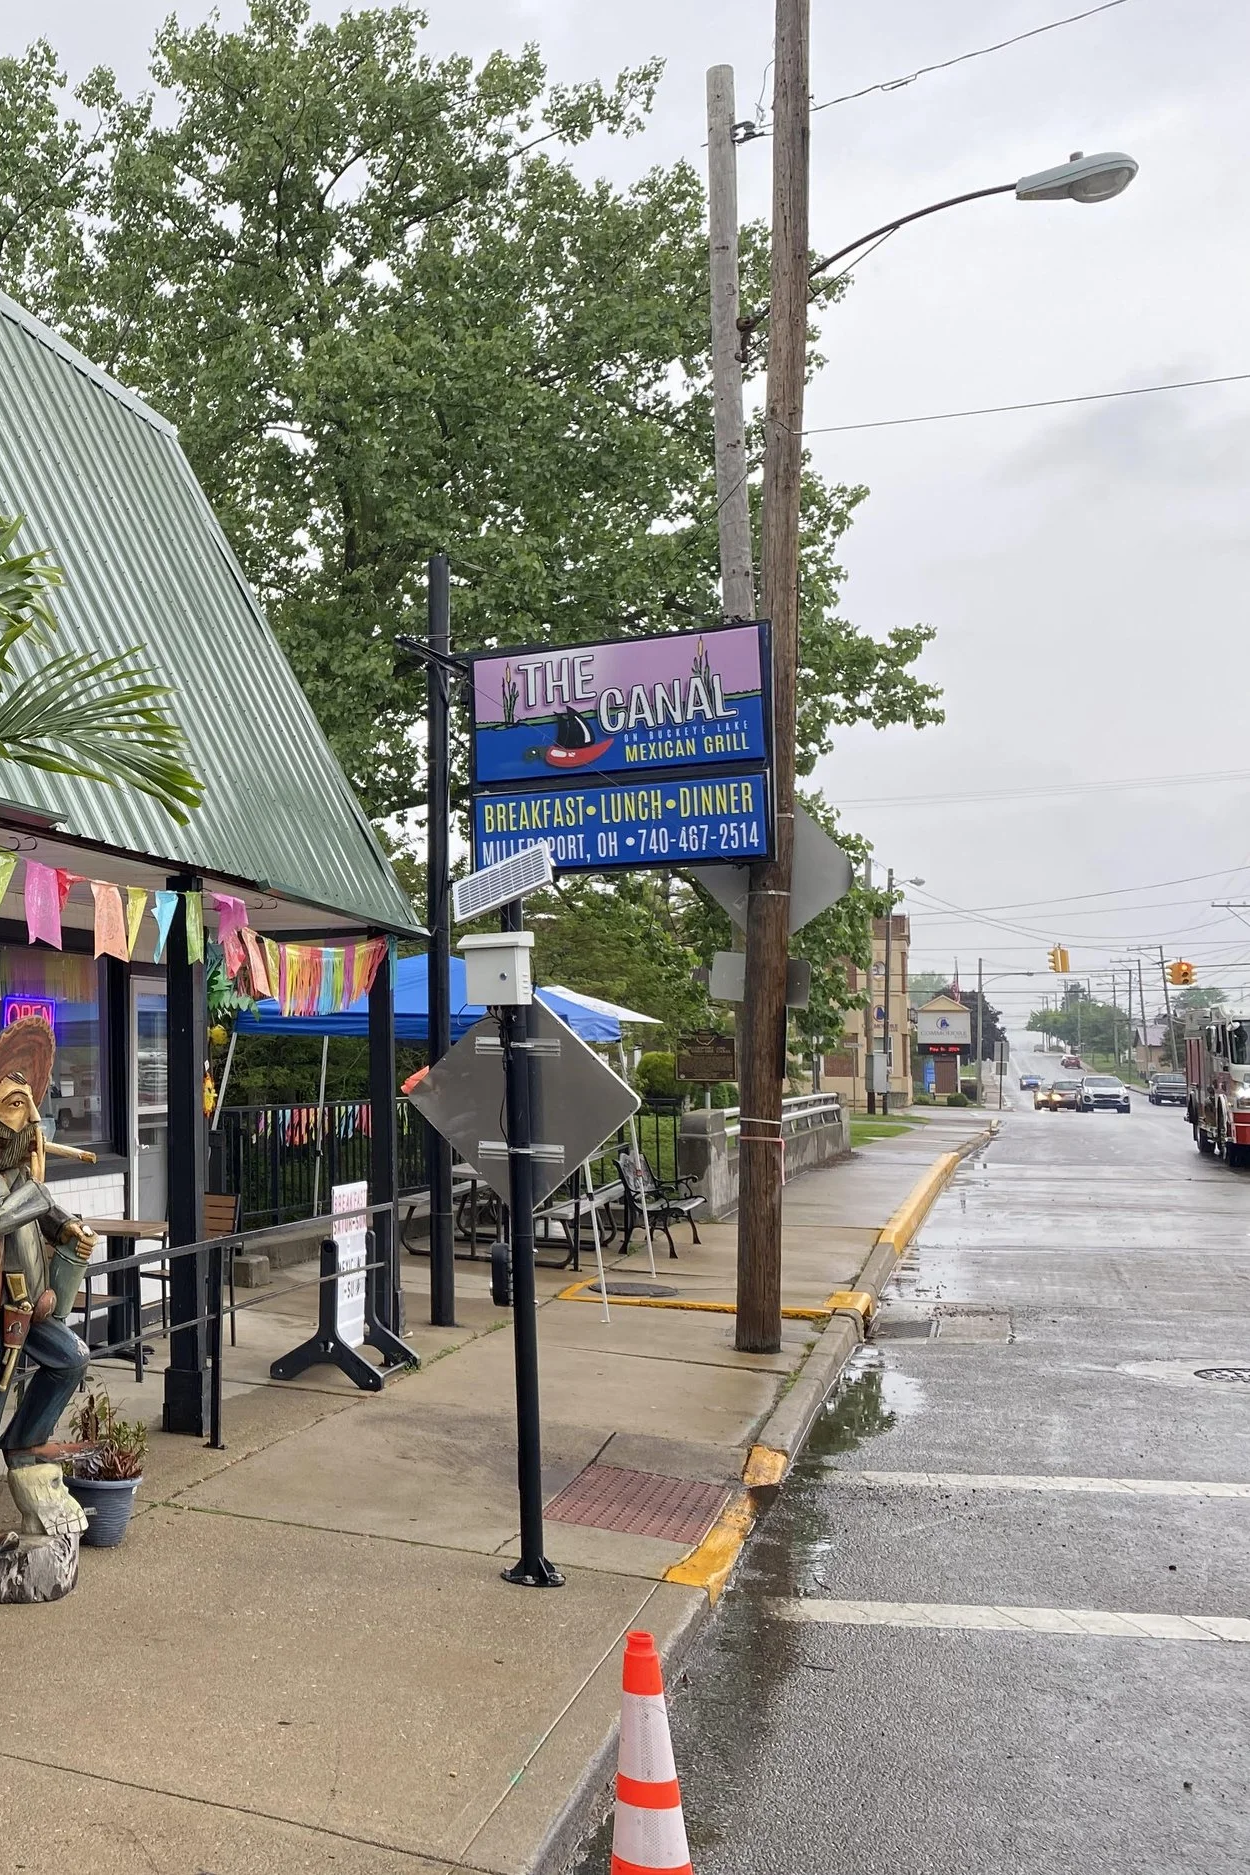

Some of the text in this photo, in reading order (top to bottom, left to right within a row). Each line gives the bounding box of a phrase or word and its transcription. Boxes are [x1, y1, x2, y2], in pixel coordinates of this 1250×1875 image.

[517, 653, 597, 709] THE
[598, 673, 739, 735] CANAL
[624, 720, 749, 743] ON BUCKEYE LAKE
[625, 732, 750, 762] MEXICAN GRILL
[484, 782, 754, 834] BREAKFAST LUNCH DINNER
[482, 821, 760, 865] MILLPORT, OH 740-467-2514
